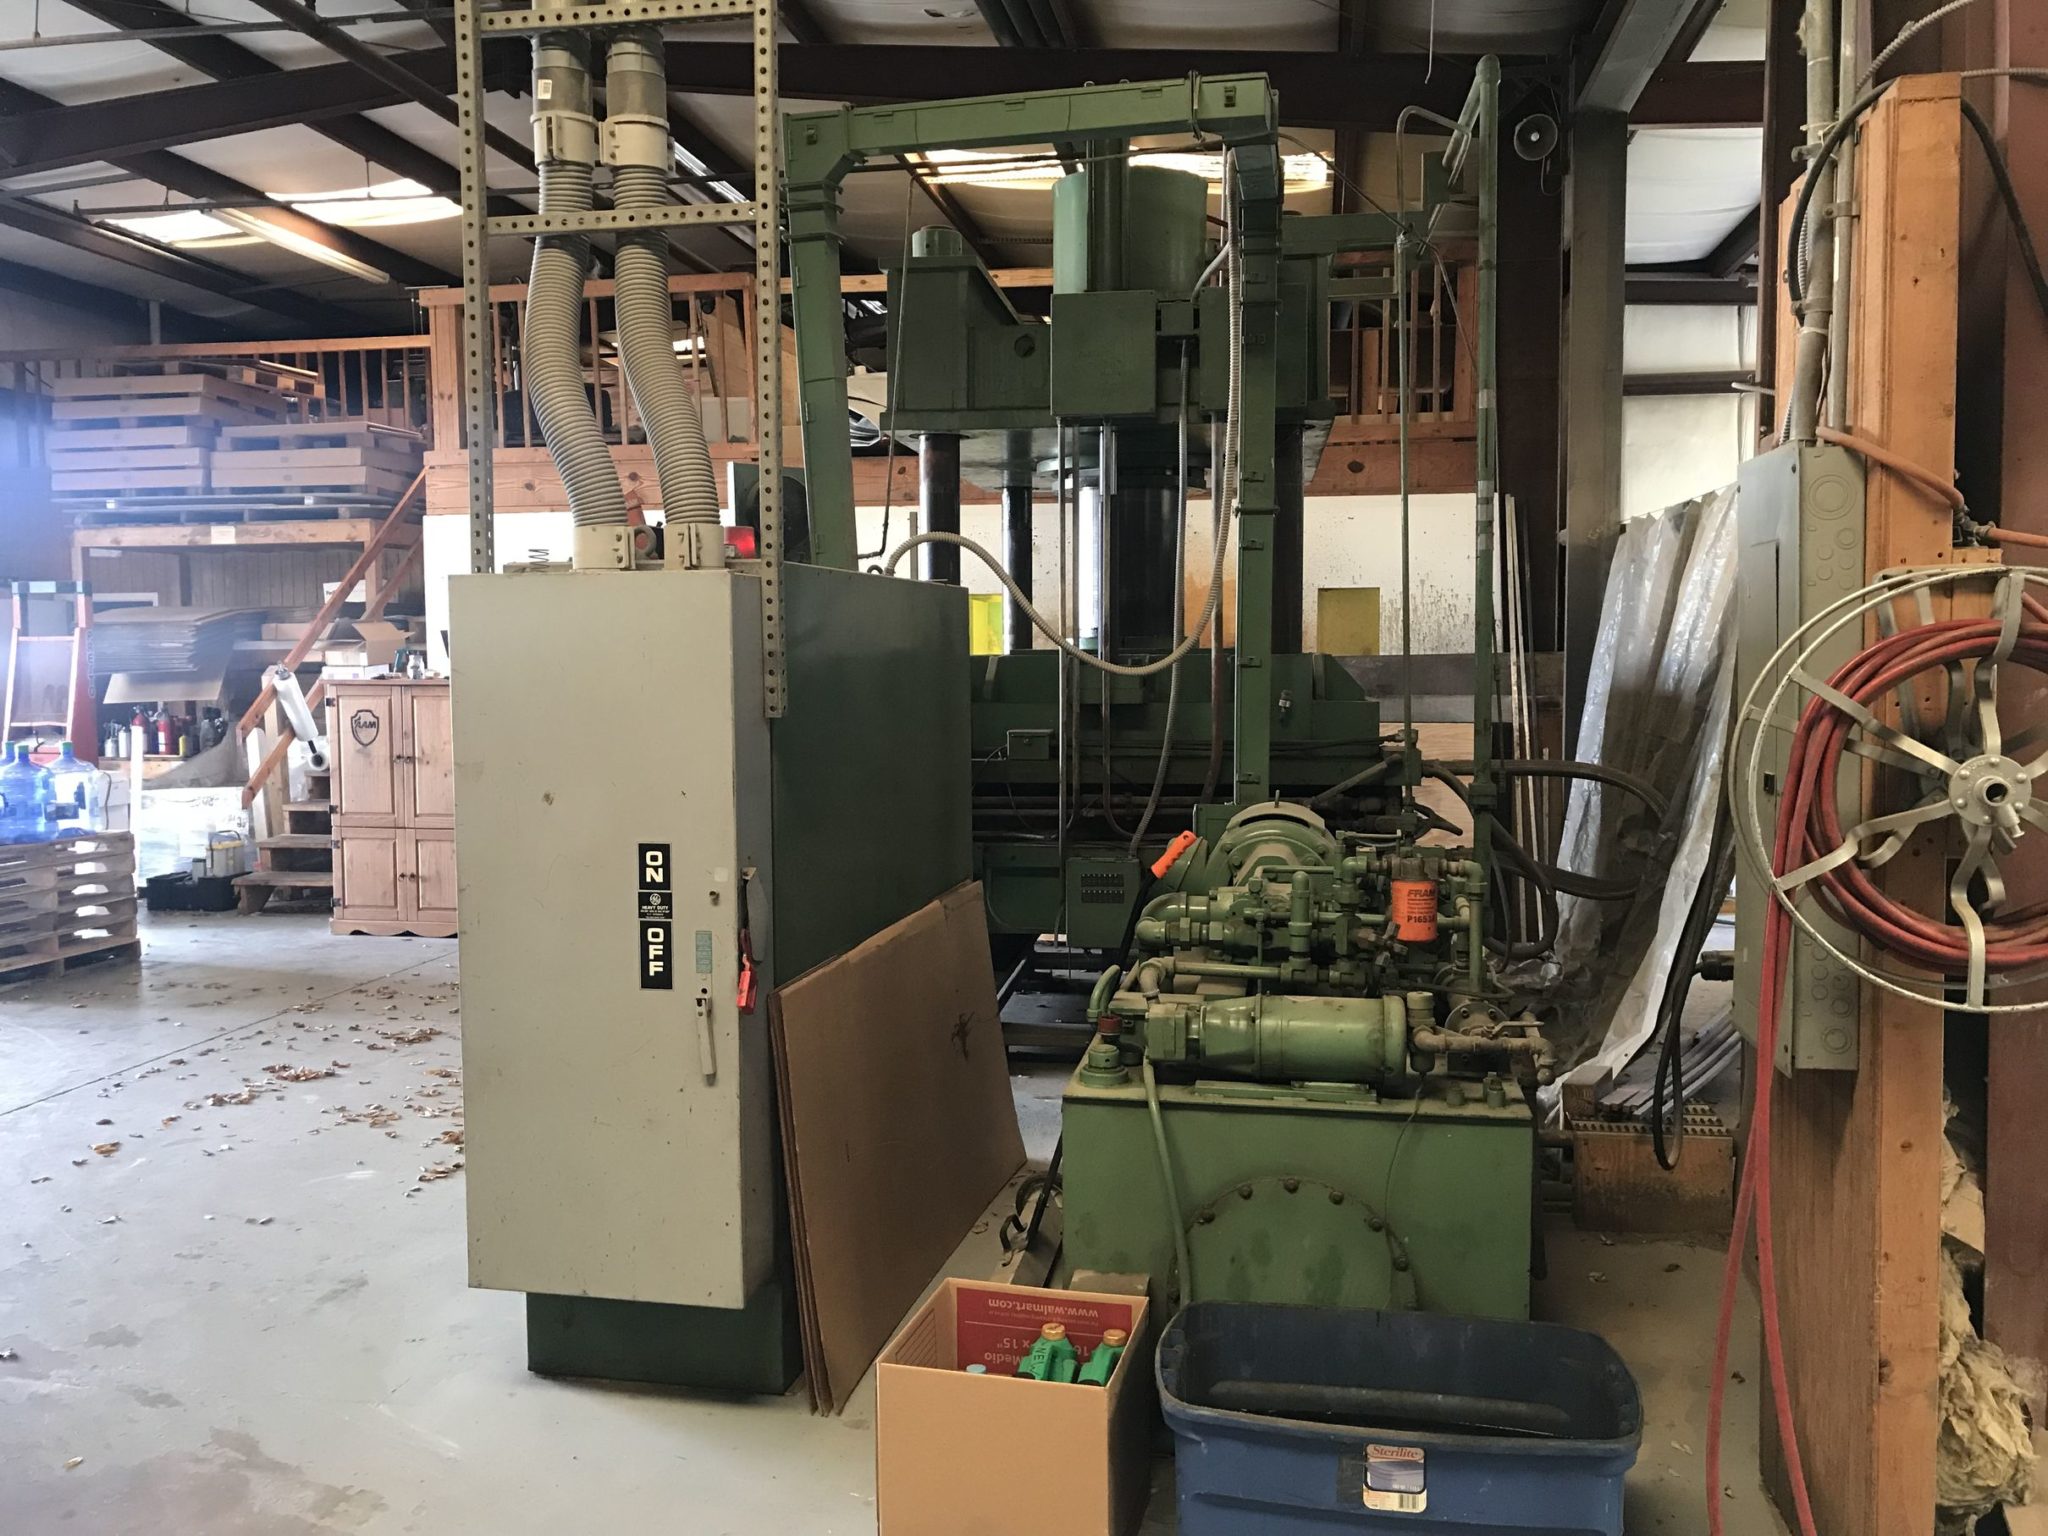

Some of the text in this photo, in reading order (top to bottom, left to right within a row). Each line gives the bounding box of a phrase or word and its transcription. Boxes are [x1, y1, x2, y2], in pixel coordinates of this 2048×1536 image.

[645, 851, 664, 882] ON
[647, 927, 664, 976] OFF
[988, 1298, 1098, 1317] www.walmart.com
[1372, 1446, 1418, 1458] Sterilite
